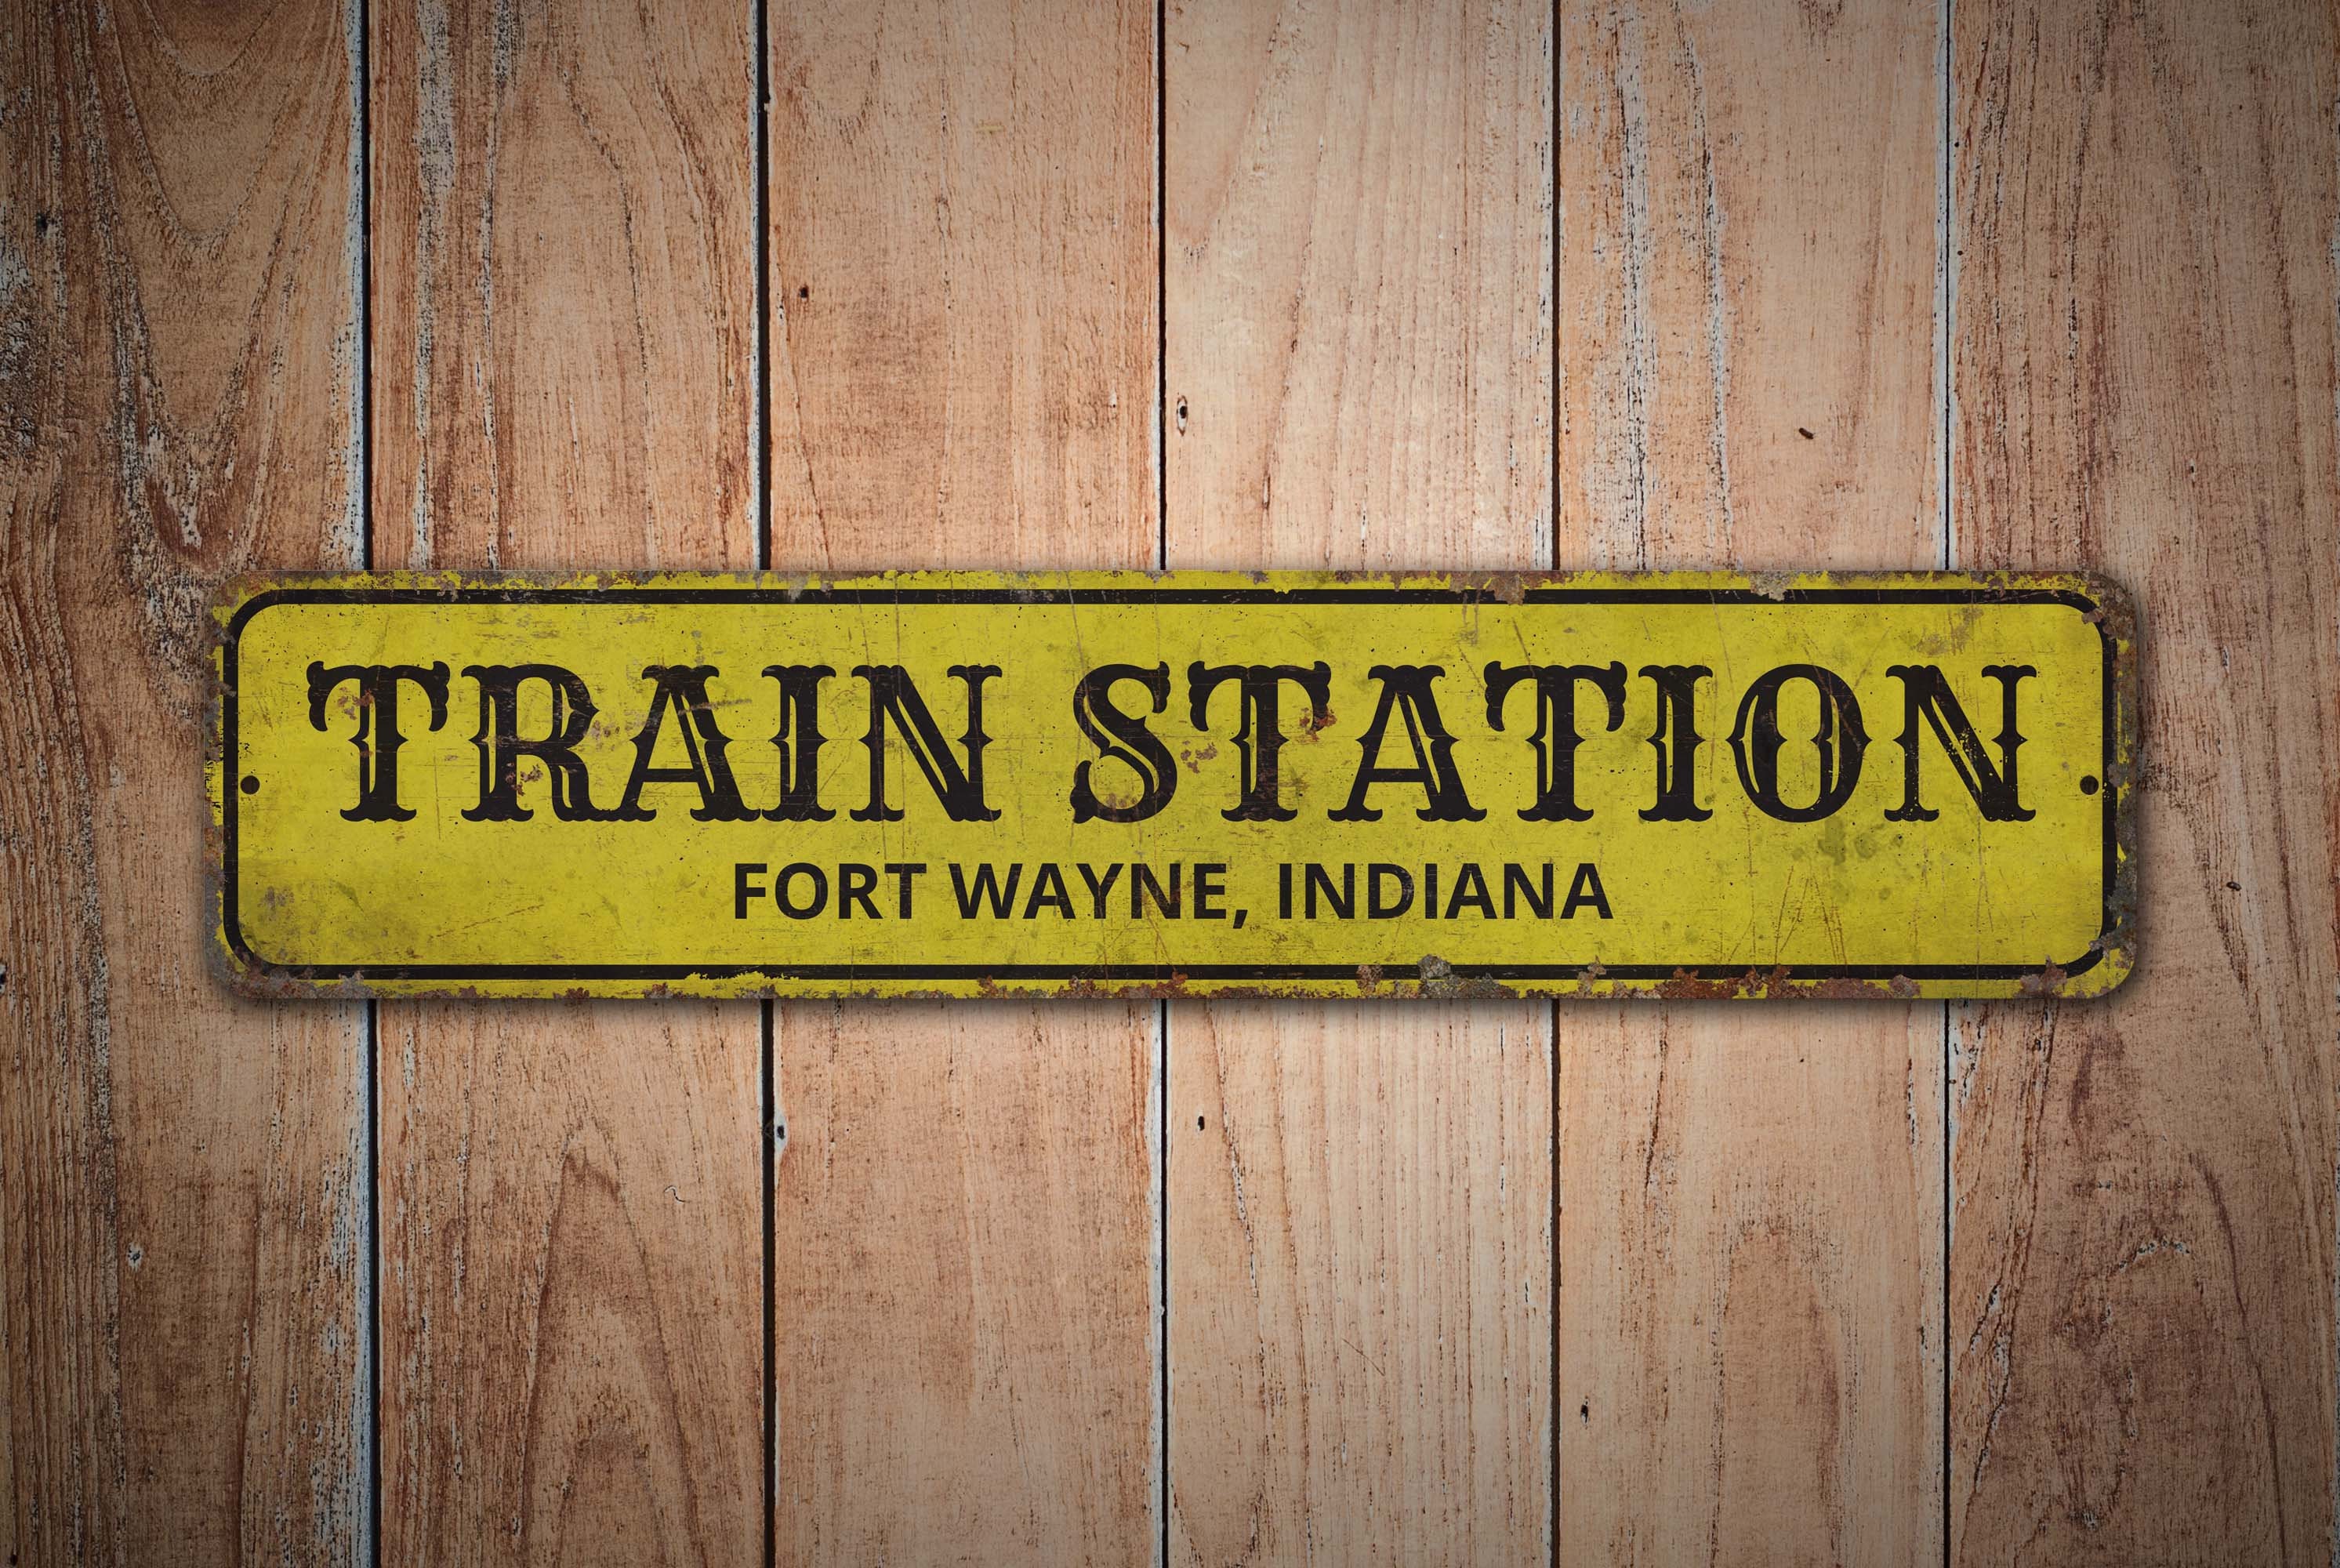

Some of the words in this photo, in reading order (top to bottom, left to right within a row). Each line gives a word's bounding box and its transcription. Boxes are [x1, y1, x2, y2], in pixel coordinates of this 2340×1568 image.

[307, 661, 1002, 823] TRAIN
[1070, 661, 2037, 824] STATION
[735, 863, 927, 920] FORT
[949, 863, 1247, 928] WAYNE,
[1279, 863, 1613, 920] INDIANA
